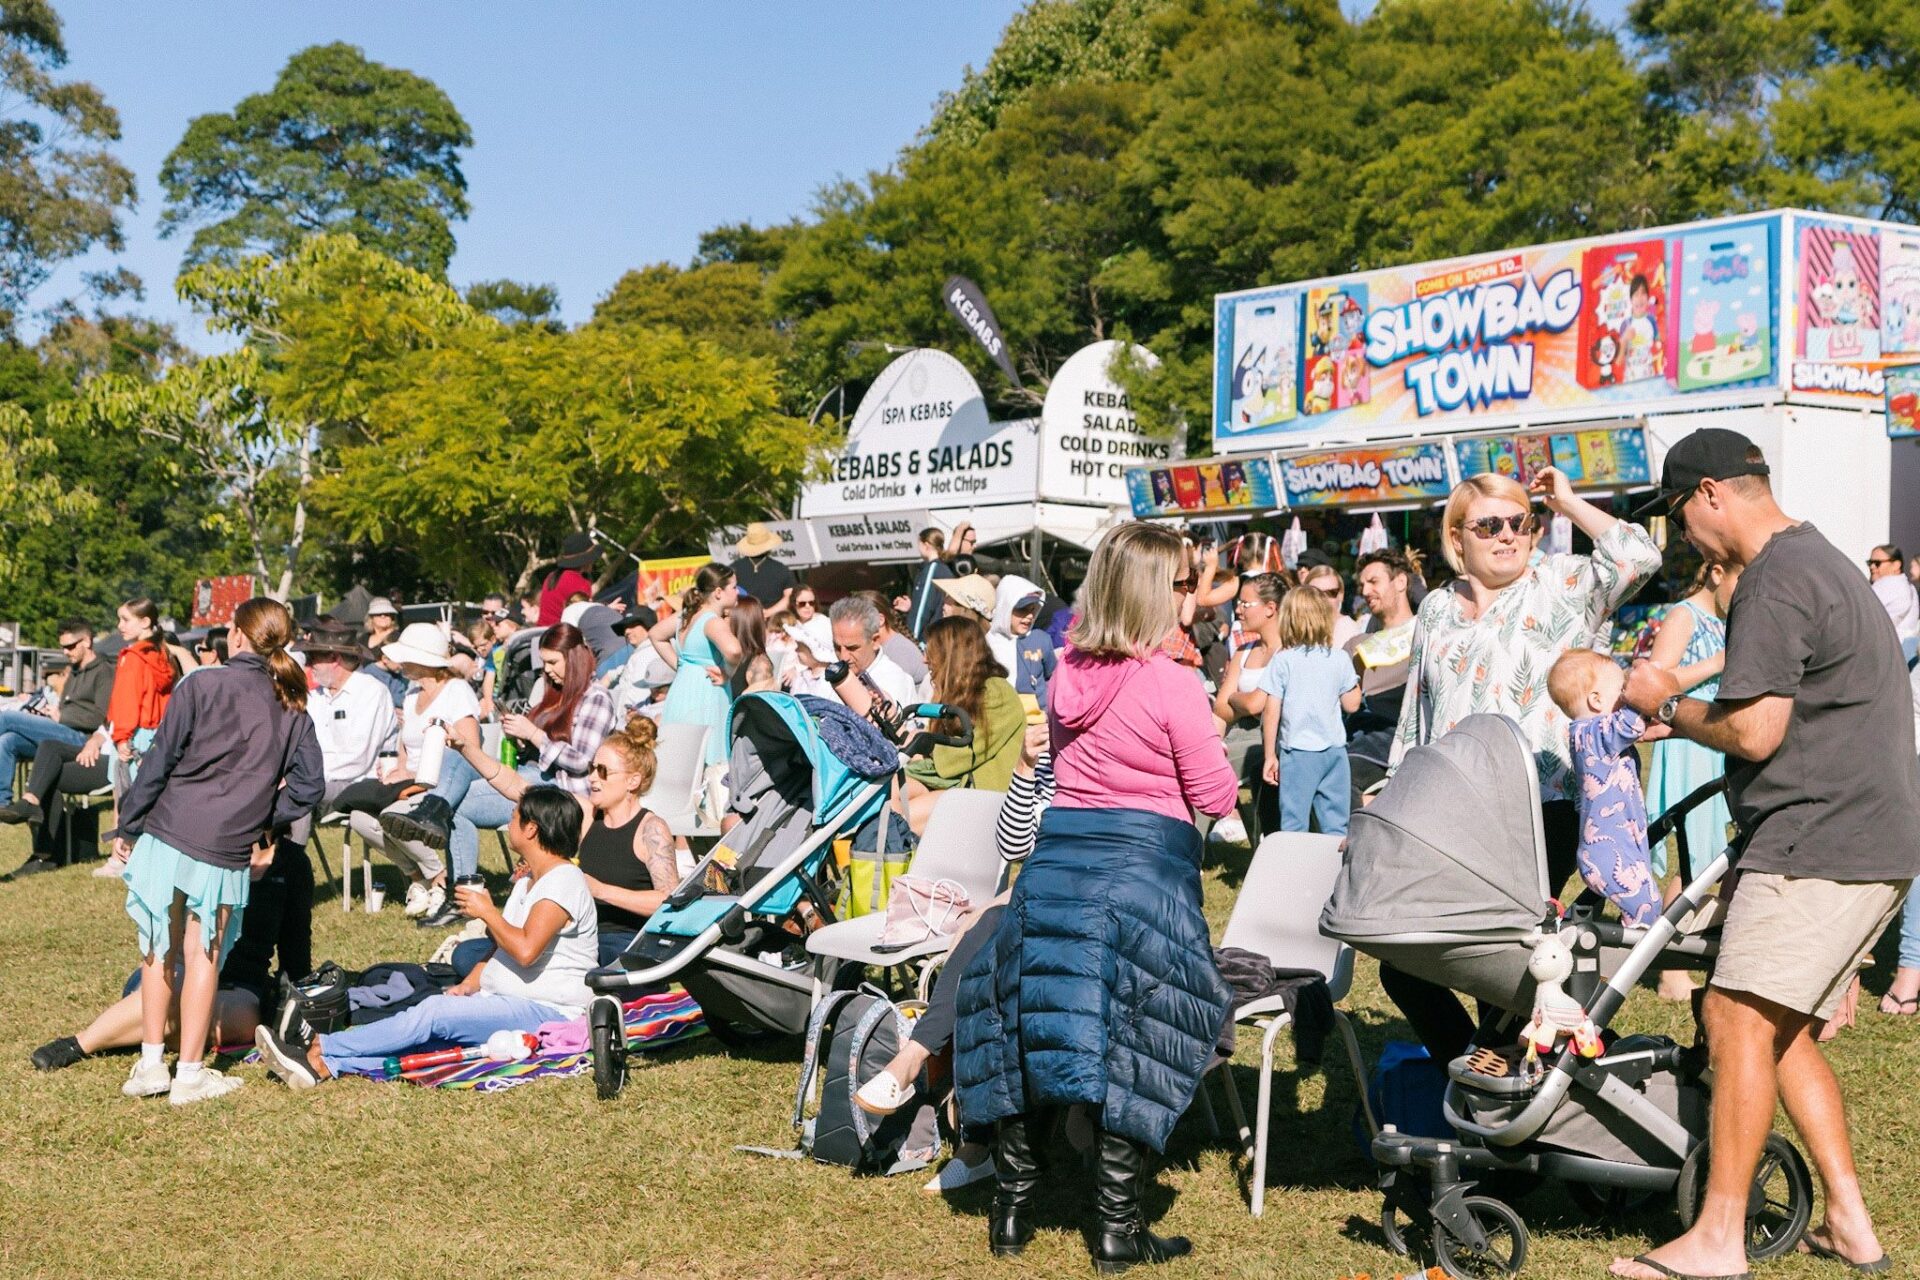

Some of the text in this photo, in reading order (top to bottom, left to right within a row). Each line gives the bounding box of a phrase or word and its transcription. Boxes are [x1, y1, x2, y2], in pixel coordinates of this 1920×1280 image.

[1417, 278, 1444, 295] COME
[1447, 271, 1463, 286] ON
[1466, 263, 1498, 280] DOWN
[950, 288, 1002, 356] KEBABS
[1364, 269, 1582, 367] SHOWBAG
[1405, 341, 1534, 417] TOWN
[1793, 363, 1885, 396] SHOWBAG
[882, 401, 953, 424] ISPA KEBABS
[1084, 390, 1129, 409] KEBA
[1083, 414, 1147, 436] SALAD
[908, 449, 920, 476] &
[927, 440, 1013, 474] SALADS
[1060, 435, 1170, 460] COLD DRINKS
[1071, 459, 1104, 478] HOT
[1286, 460, 1381, 495] SHOWBAG
[1382, 456, 1443, 488] TOWN
[842, 474, 987, 501] Cold Drinks Hot Chips
[828, 523, 865, 538] KEBABS
[874, 520, 911, 534] SALADS
